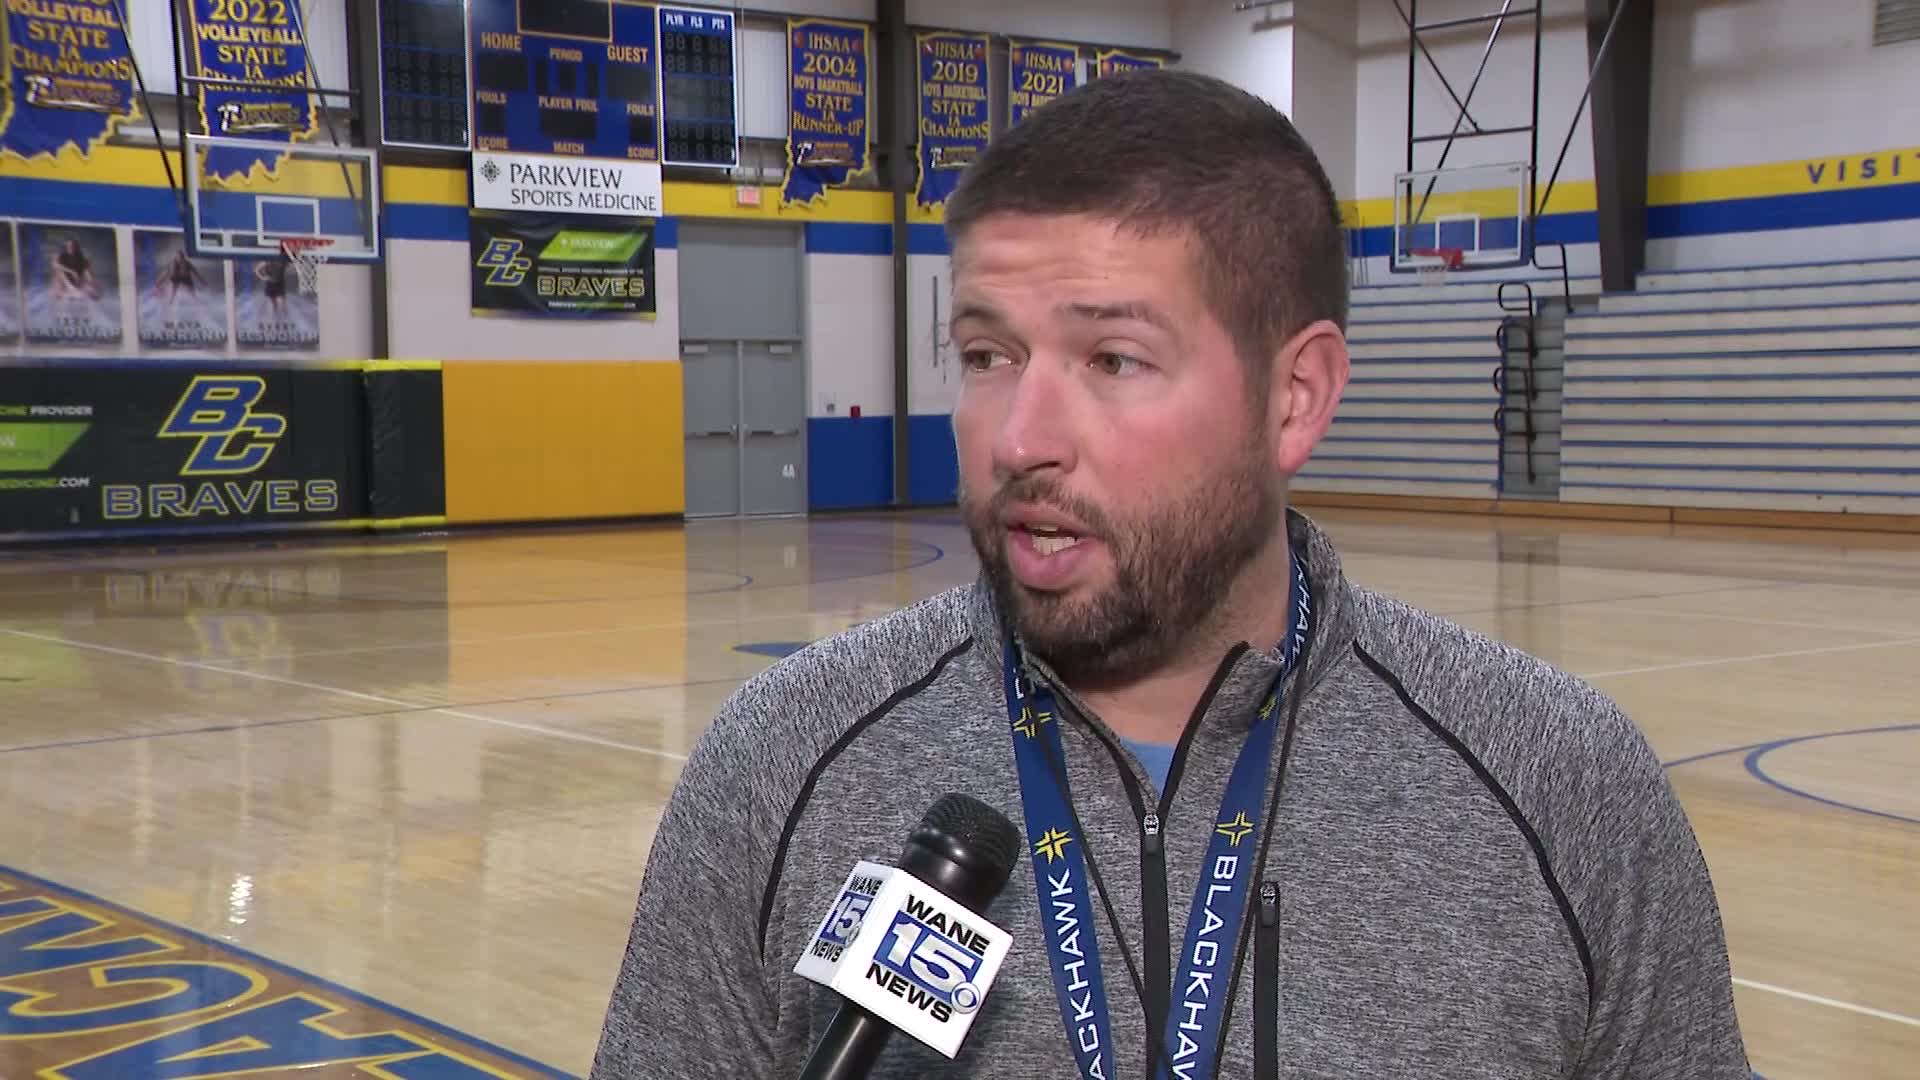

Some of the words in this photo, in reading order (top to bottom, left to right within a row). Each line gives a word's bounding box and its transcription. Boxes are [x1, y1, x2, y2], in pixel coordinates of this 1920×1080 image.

[208, 0, 288, 24] 2022
[28, 20, 110, 49] STATE
[198, 23, 302, 45] VOLLEYBALL
[481, 32, 521, 50] HOME
[808, 32, 850, 52] IHSAA
[9, 43, 132, 80] CHAMPIONS
[217, 44, 287, 65] STATE
[550, 48, 583, 62] PERIOD
[607, 46, 648, 63] GUEST
[935, 42, 974, 59] IHSAA
[803, 52, 856, 77] 2004
[932, 61, 978, 83] 2019
[1026, 52, 1062, 72] IHSAA
[1022, 72, 1064, 94] 2021
[538, 96, 573, 110] PLAYER
[627, 104, 655, 116] FOULS
[805, 92, 852, 112] STATE
[932, 100, 976, 116] STATE
[793, 112, 864, 136] RUNNER-UP
[922, 118, 990, 140] CHAMPIONS
[477, 136, 508, 150] SCORE
[553, 142, 584, 154] MATCH
[627, 146, 656, 159] SCORE
[510, 163, 622, 189] PARKVIEW
[1807, 152, 1920, 184] VISI
[511, 189, 573, 207] SPORTS
[578, 192, 657, 211] MEDICINE
[477, 237, 532, 286] BC
[537, 275, 646, 297] BRAVES
[31, 406, 93, 416] PROVIDER
[156, 375, 288, 476] BC
[102, 480, 339, 519] BRAVES
[849, 875, 883, 896] WANE
[823, 892, 869, 944] 15
[905, 894, 991, 957] WANE
[809, 940, 844, 963] NEWS
[887, 920, 978, 995] 15
[1047, 867, 1106, 1080] ACKHAWK
[865, 962, 954, 1024] NEWS
